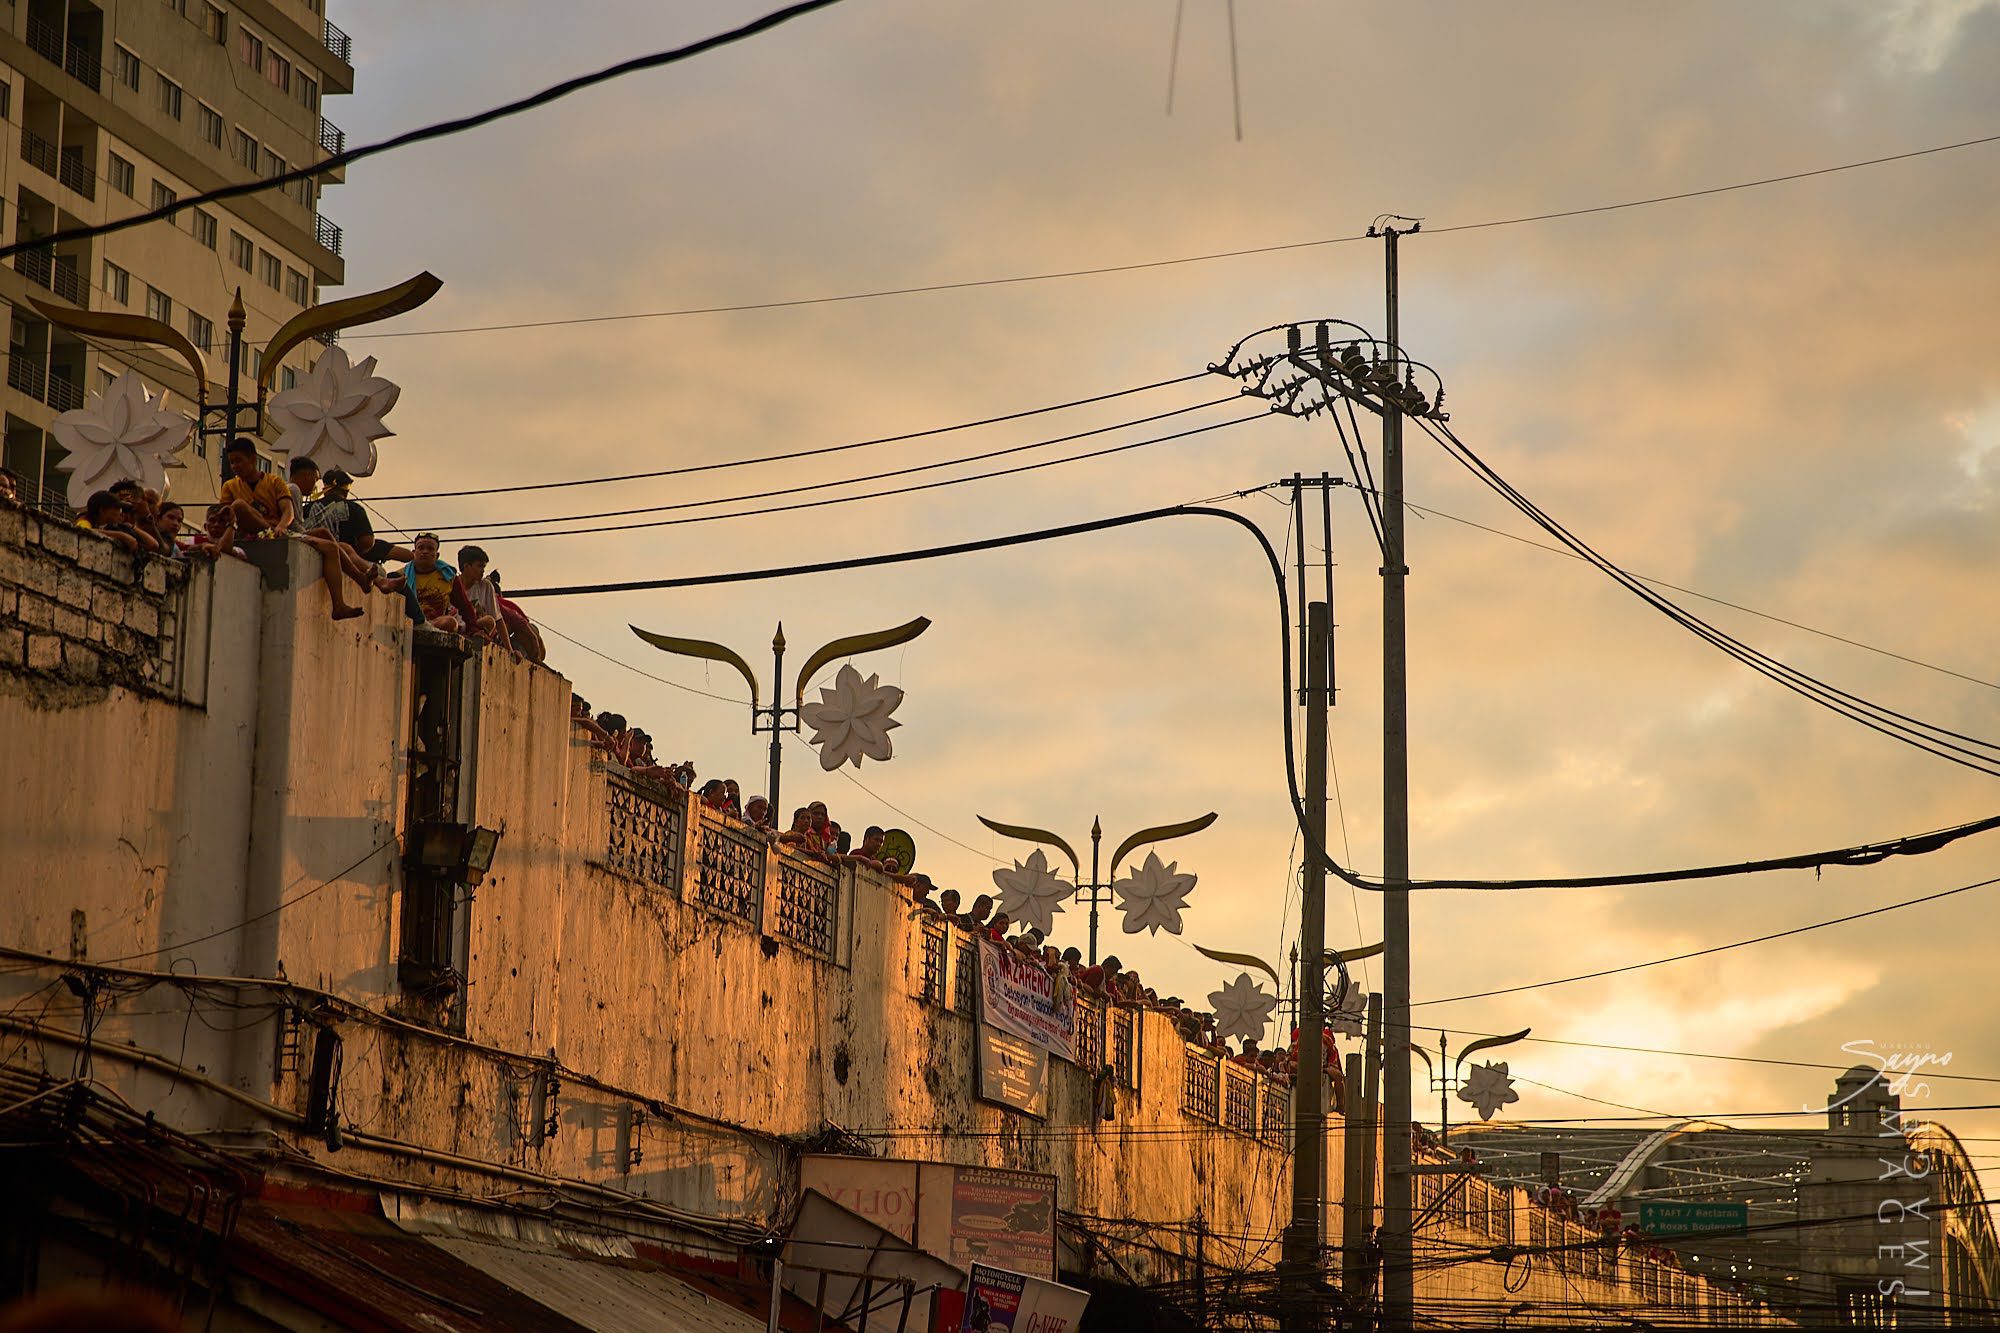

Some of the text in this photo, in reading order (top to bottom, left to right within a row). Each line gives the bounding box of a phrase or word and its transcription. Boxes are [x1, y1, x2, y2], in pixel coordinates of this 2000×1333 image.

[1660, 1208, 1681, 1216] TAFT
[1660, 1222, 1688, 1230] Roxas
[975, 1266, 1021, 1284] MOTORCYCLE
[974, 1274, 1022, 1292] RIDER PROMO
